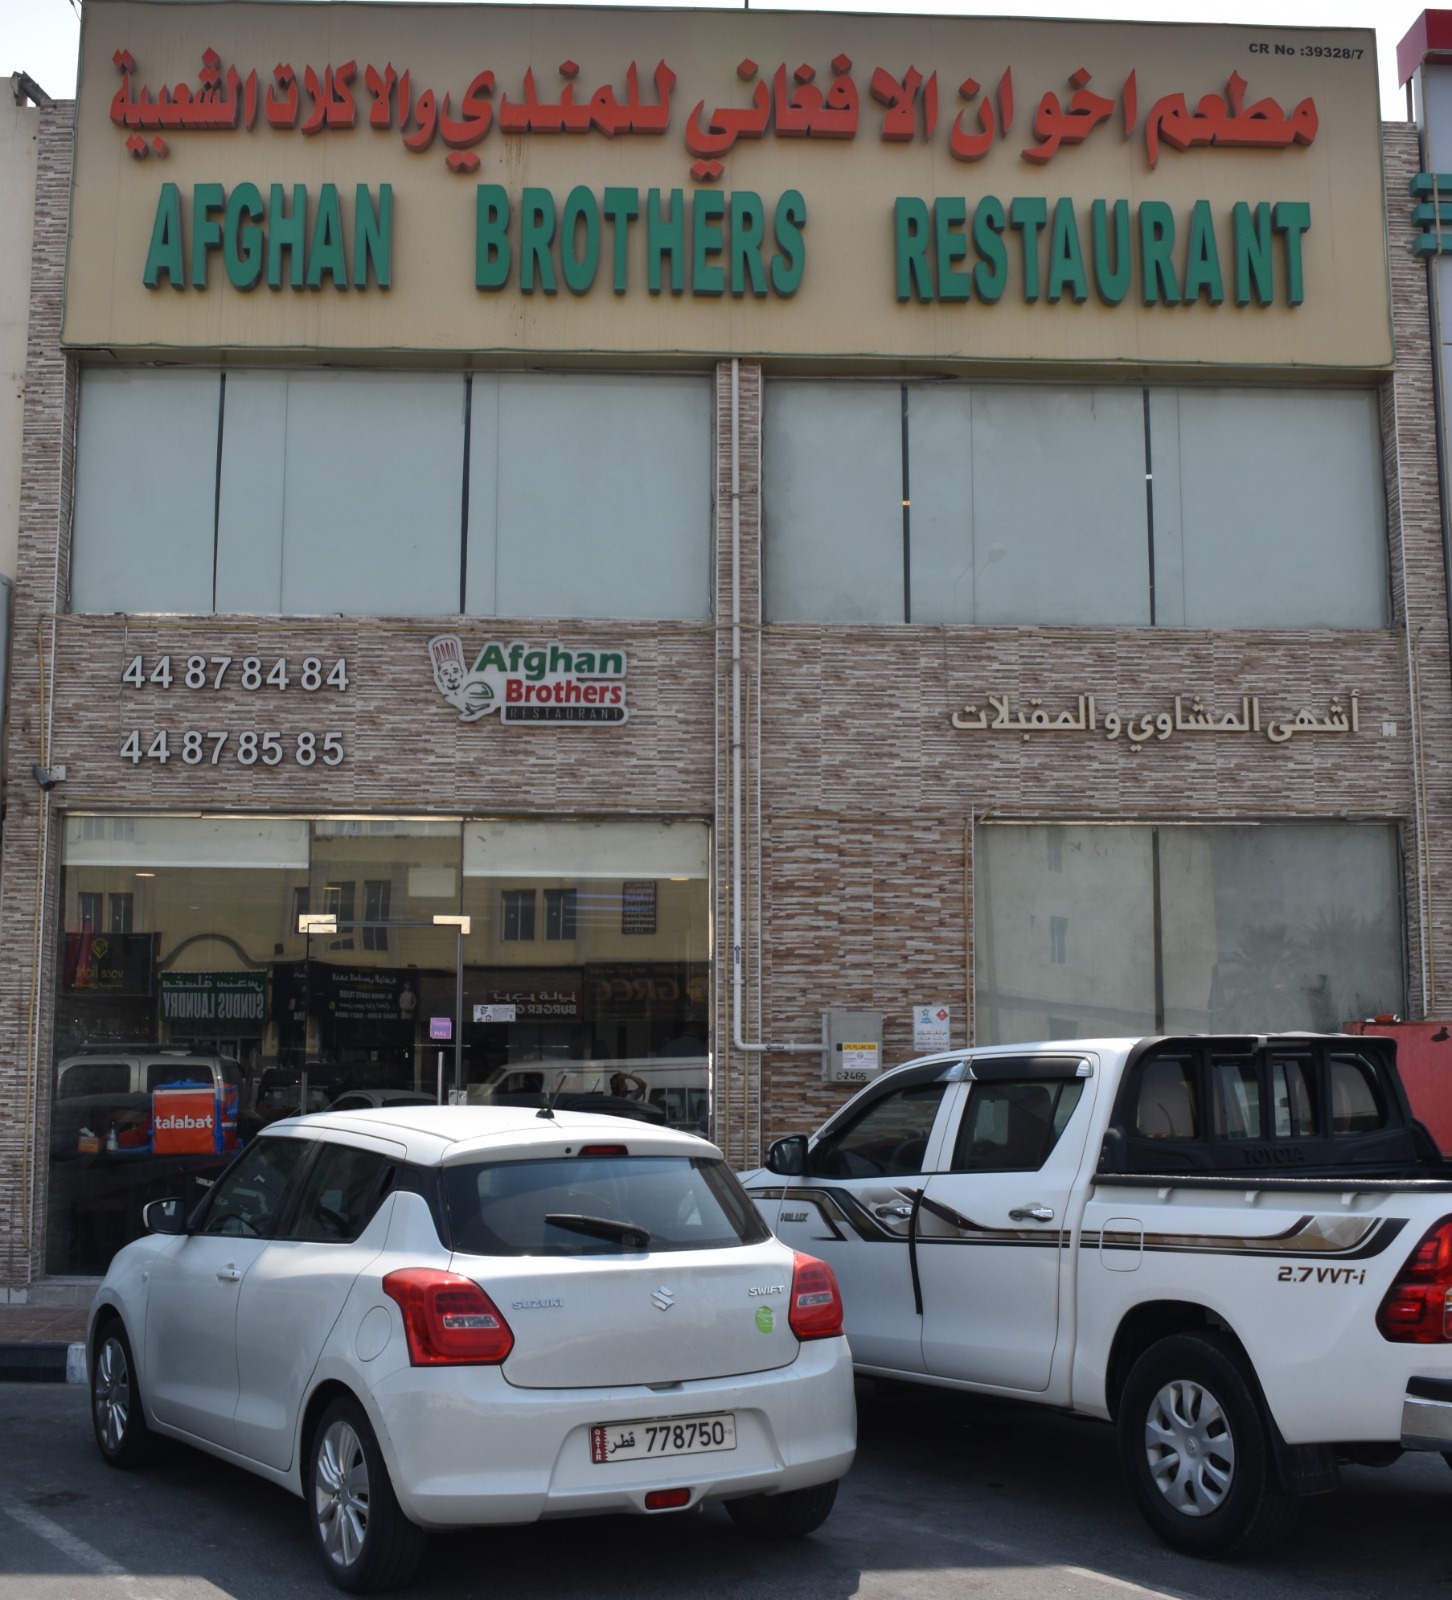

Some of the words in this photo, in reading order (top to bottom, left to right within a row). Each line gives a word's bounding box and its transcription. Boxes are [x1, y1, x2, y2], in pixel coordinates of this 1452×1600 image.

[1248, 43, 1270, 54] CR
[1274, 44, 1295, 56] No
[109, 46, 257, 160] الشعبية
[439, 57, 677, 172] للمندي
[686, 53, 938, 183] الافغاني
[951, 65, 1138, 165] اخوان
[1146, 70, 1319, 169] مطعم
[142, 182, 393, 292] AFGHAN
[475, 184, 806, 297] BROTHERS
[894, 195, 1311, 308] RESTAURANT
[122, 655, 173, 689] 44
[184, 655, 232, 690] 87
[241, 656, 290, 691] 84
[300, 657, 349, 691] 84
[475, 644, 623, 682] Afghan
[505, 679, 622, 704] Brothers
[510, 707, 620, 720] RESTAURANT
[951, 694, 1096, 741] المقبلات
[1104, 710, 1121, 741] و
[120, 729, 170, 764] 44
[182, 730, 229, 765] 87
[237, 731, 283, 766] 85
[295, 731, 344, 766] 85
[154, 1114, 214, 1130] talabat
[1243, 1146, 1305, 1163] TOYOTA
[749, 1284, 785, 1297] SWIFT
[1277, 1266, 1313, 1283] 2.7
[1317, 1267, 1366, 1285] VVT-i
[512, 1298, 564, 1310] SUZUKI
[594, 1429, 602, 1462] QATAR
[608, 1431, 636, 1454] قطر
[645, 1420, 725, 1453] 778750
